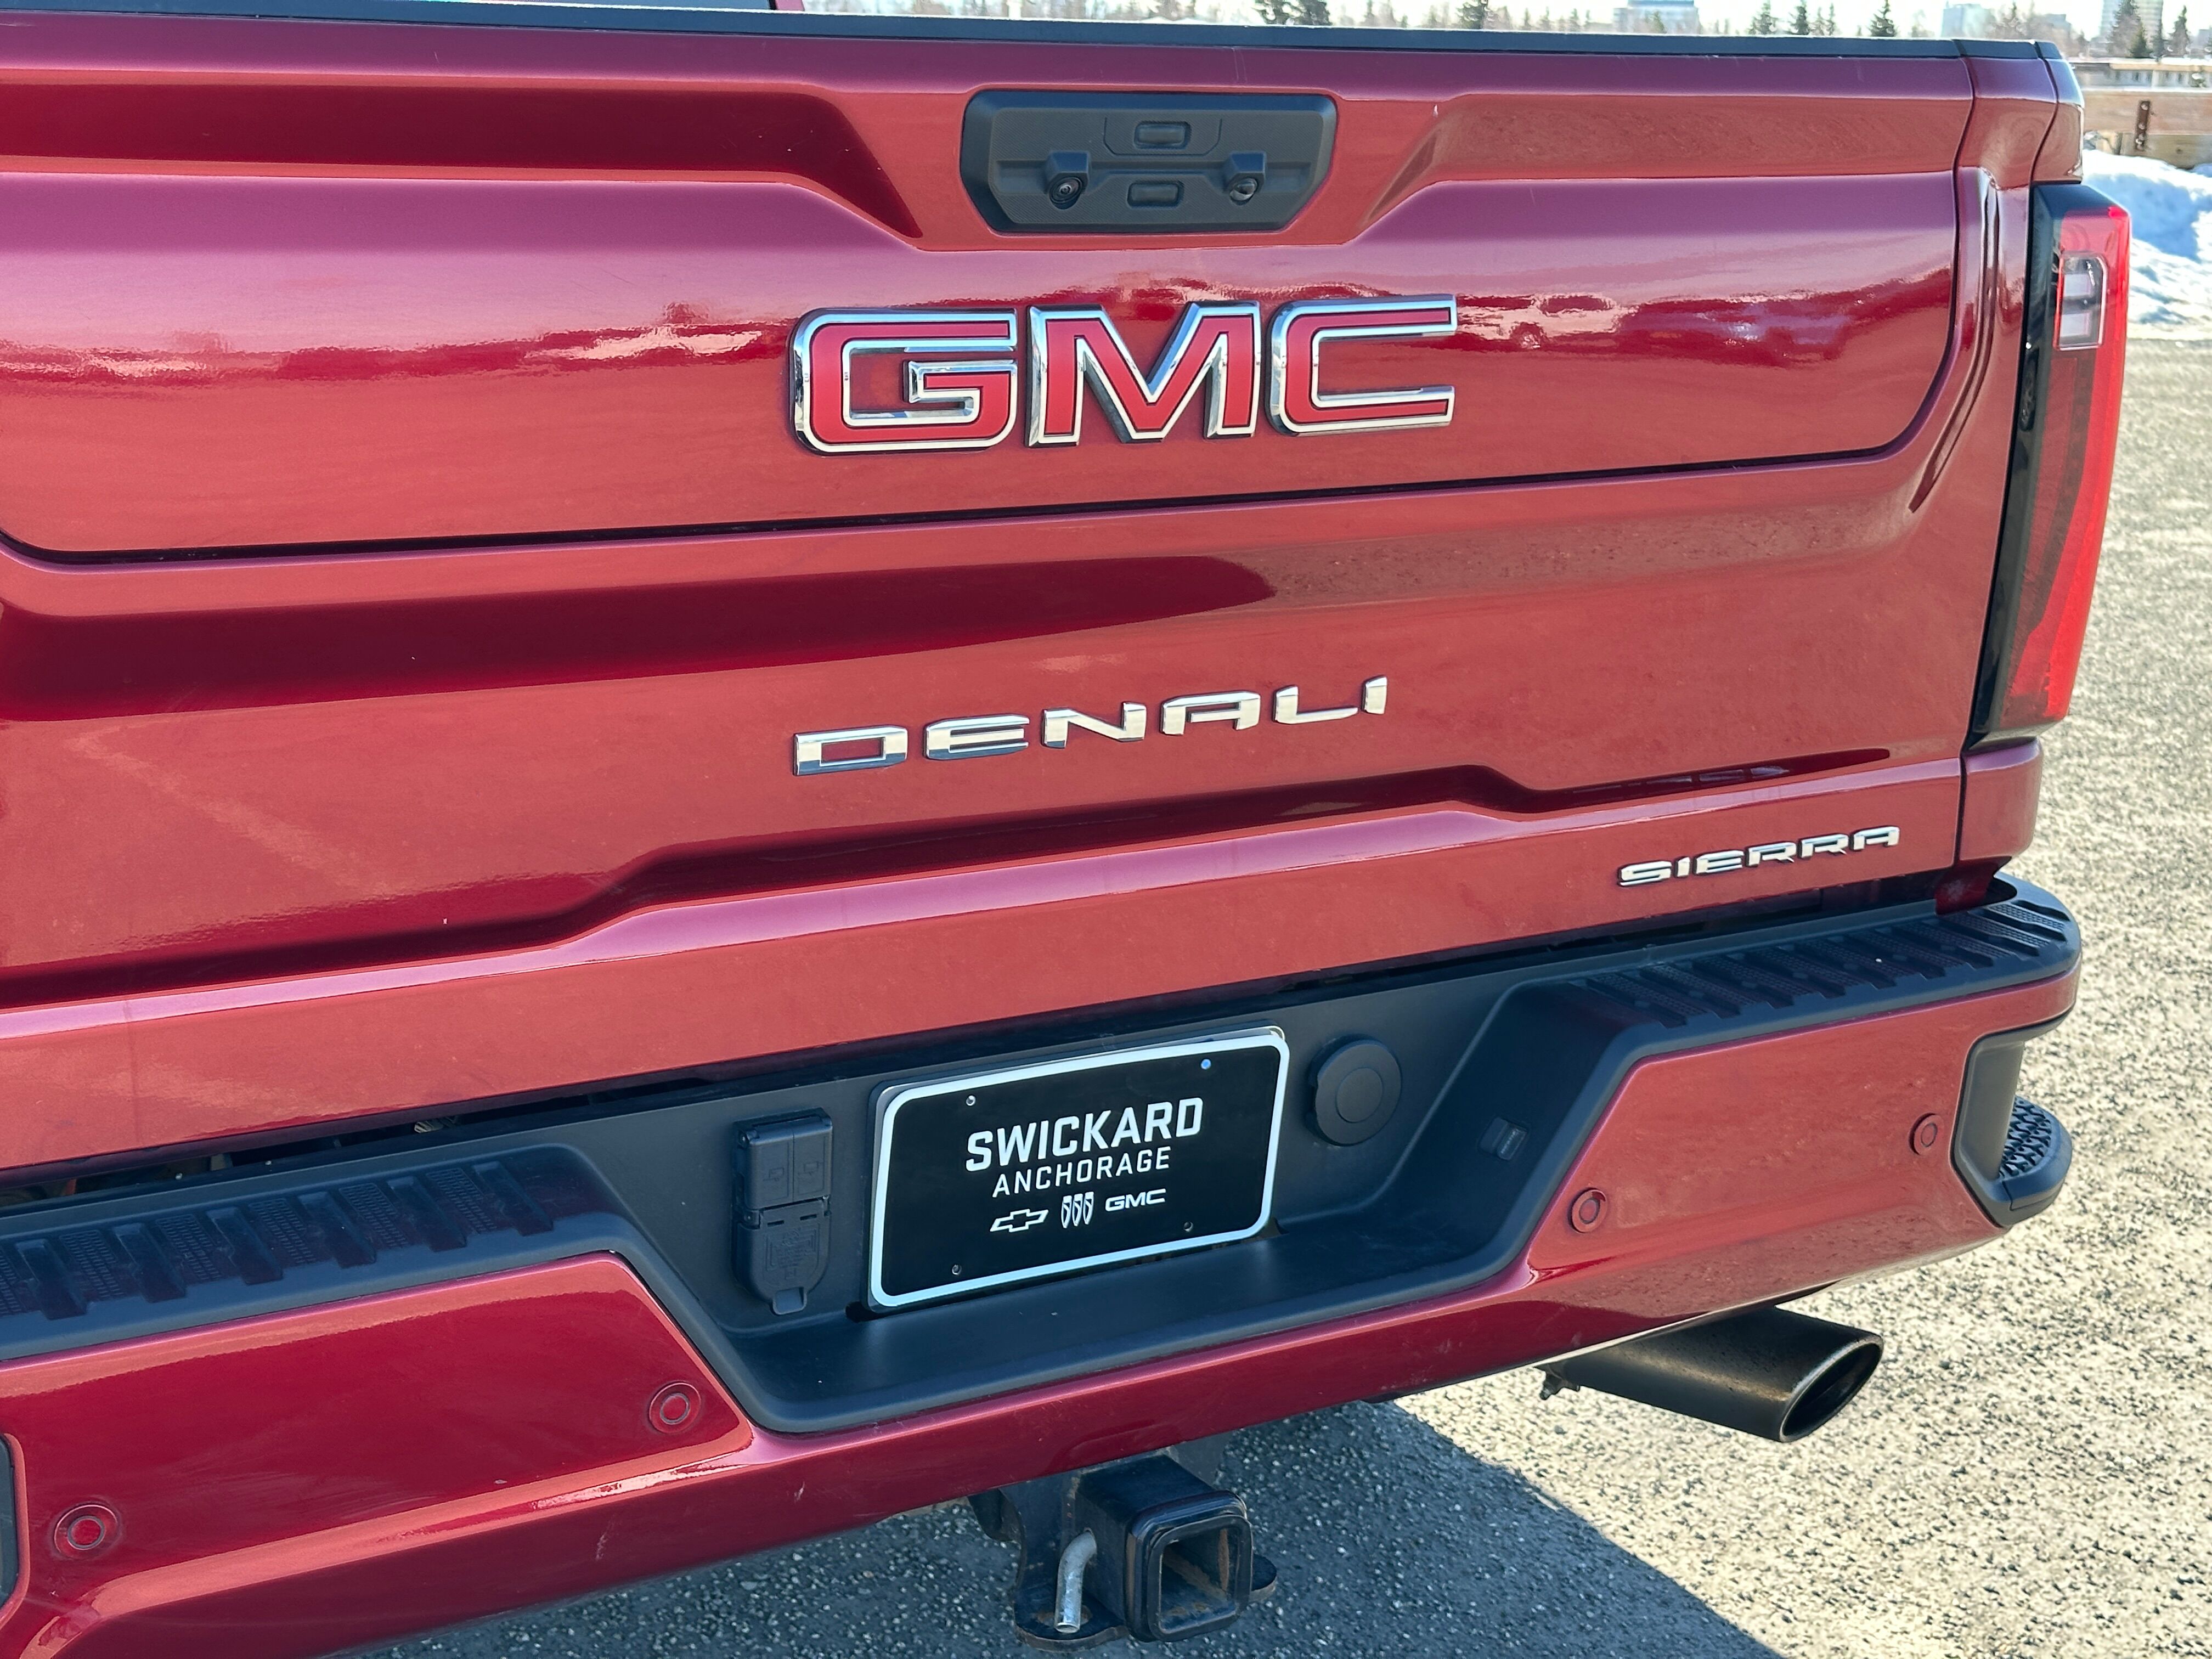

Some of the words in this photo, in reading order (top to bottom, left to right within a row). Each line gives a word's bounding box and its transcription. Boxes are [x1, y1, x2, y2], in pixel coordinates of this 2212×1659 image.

[789, 294, 1457, 454] GMC
[793, 675, 1387, 776] DENALI
[1618, 825, 1900, 887] SIERRA
[966, 1097, 1204, 1172] SWICKARD
[992, 1146, 1171, 1198] ANCHORAGE
[1105, 1188, 1167, 1212] GMC
